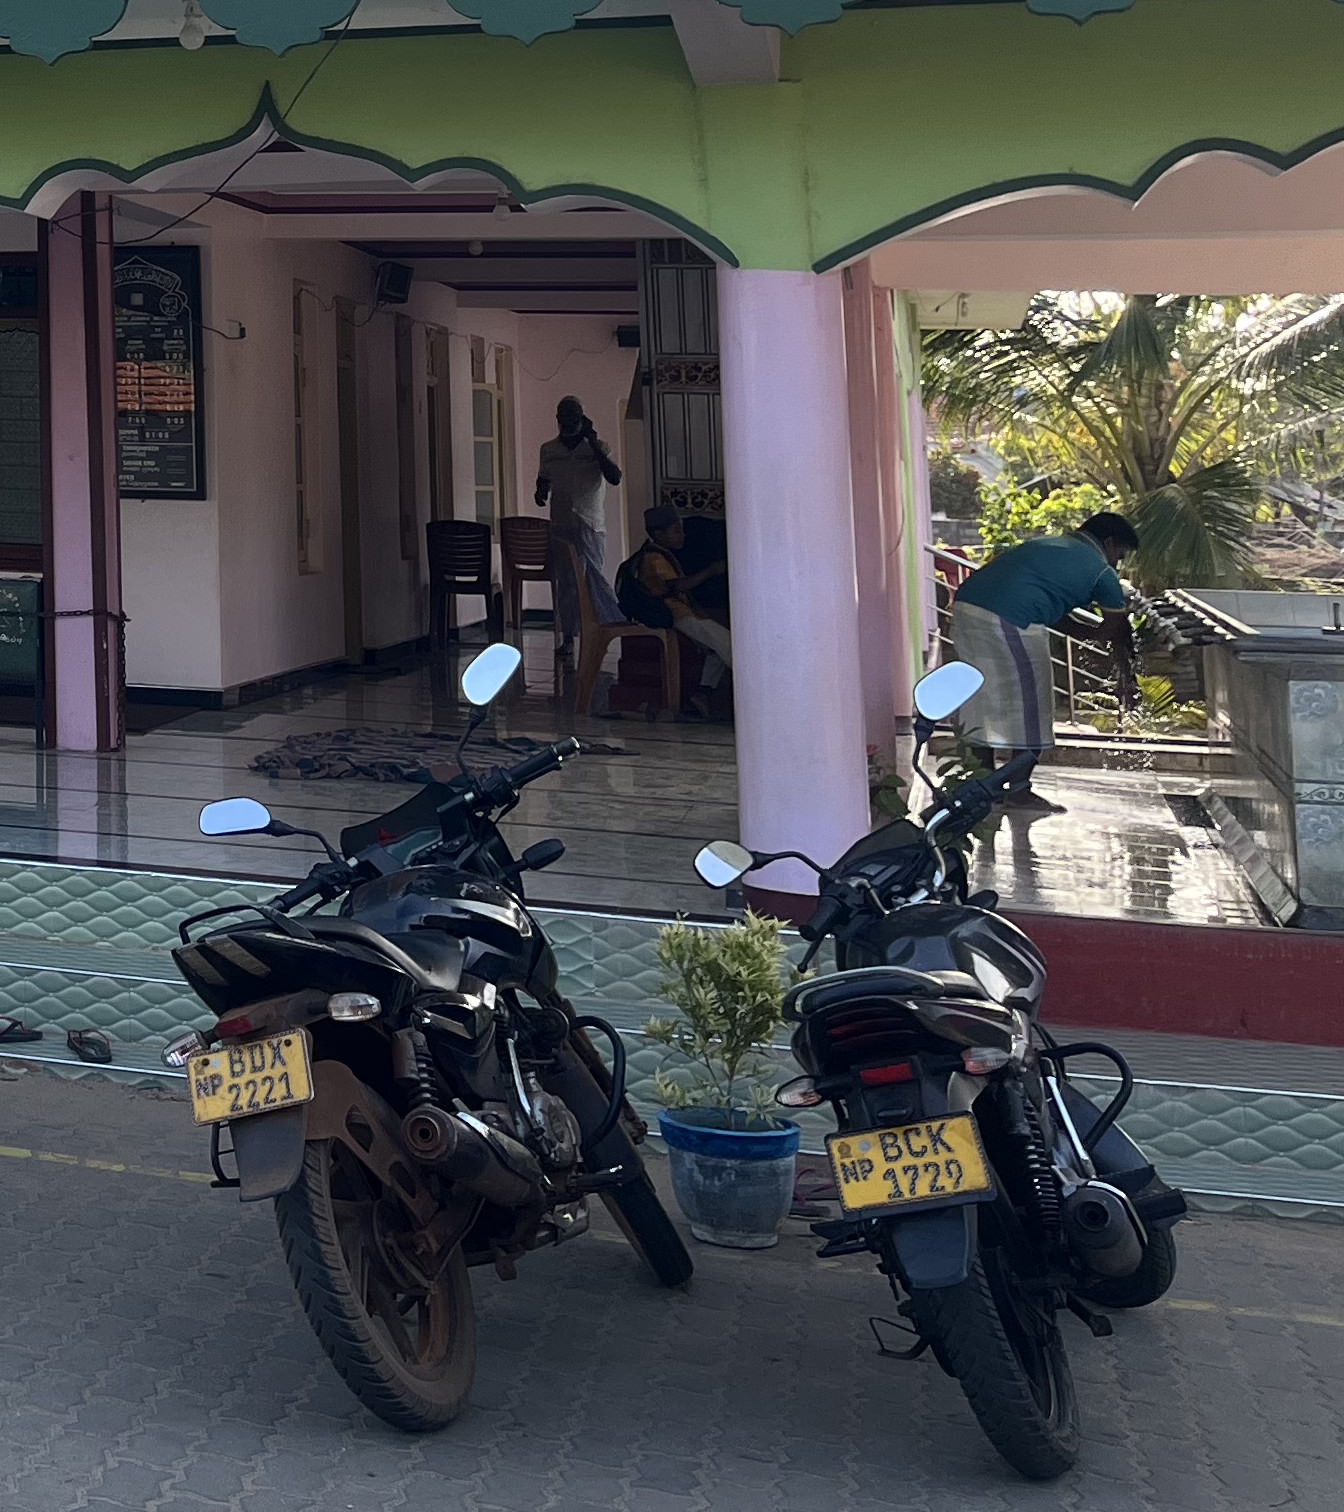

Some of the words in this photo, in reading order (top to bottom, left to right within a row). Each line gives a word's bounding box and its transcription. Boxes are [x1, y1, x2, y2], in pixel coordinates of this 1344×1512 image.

[228, 1038, 287, 1079] BDX
[195, 1073, 223, 1101] NP
[228, 1071, 295, 1112] 2221
[878, 1122, 955, 1163] BCK
[840, 1157, 874, 1184] NP
[883, 1158, 964, 1201] 1729
